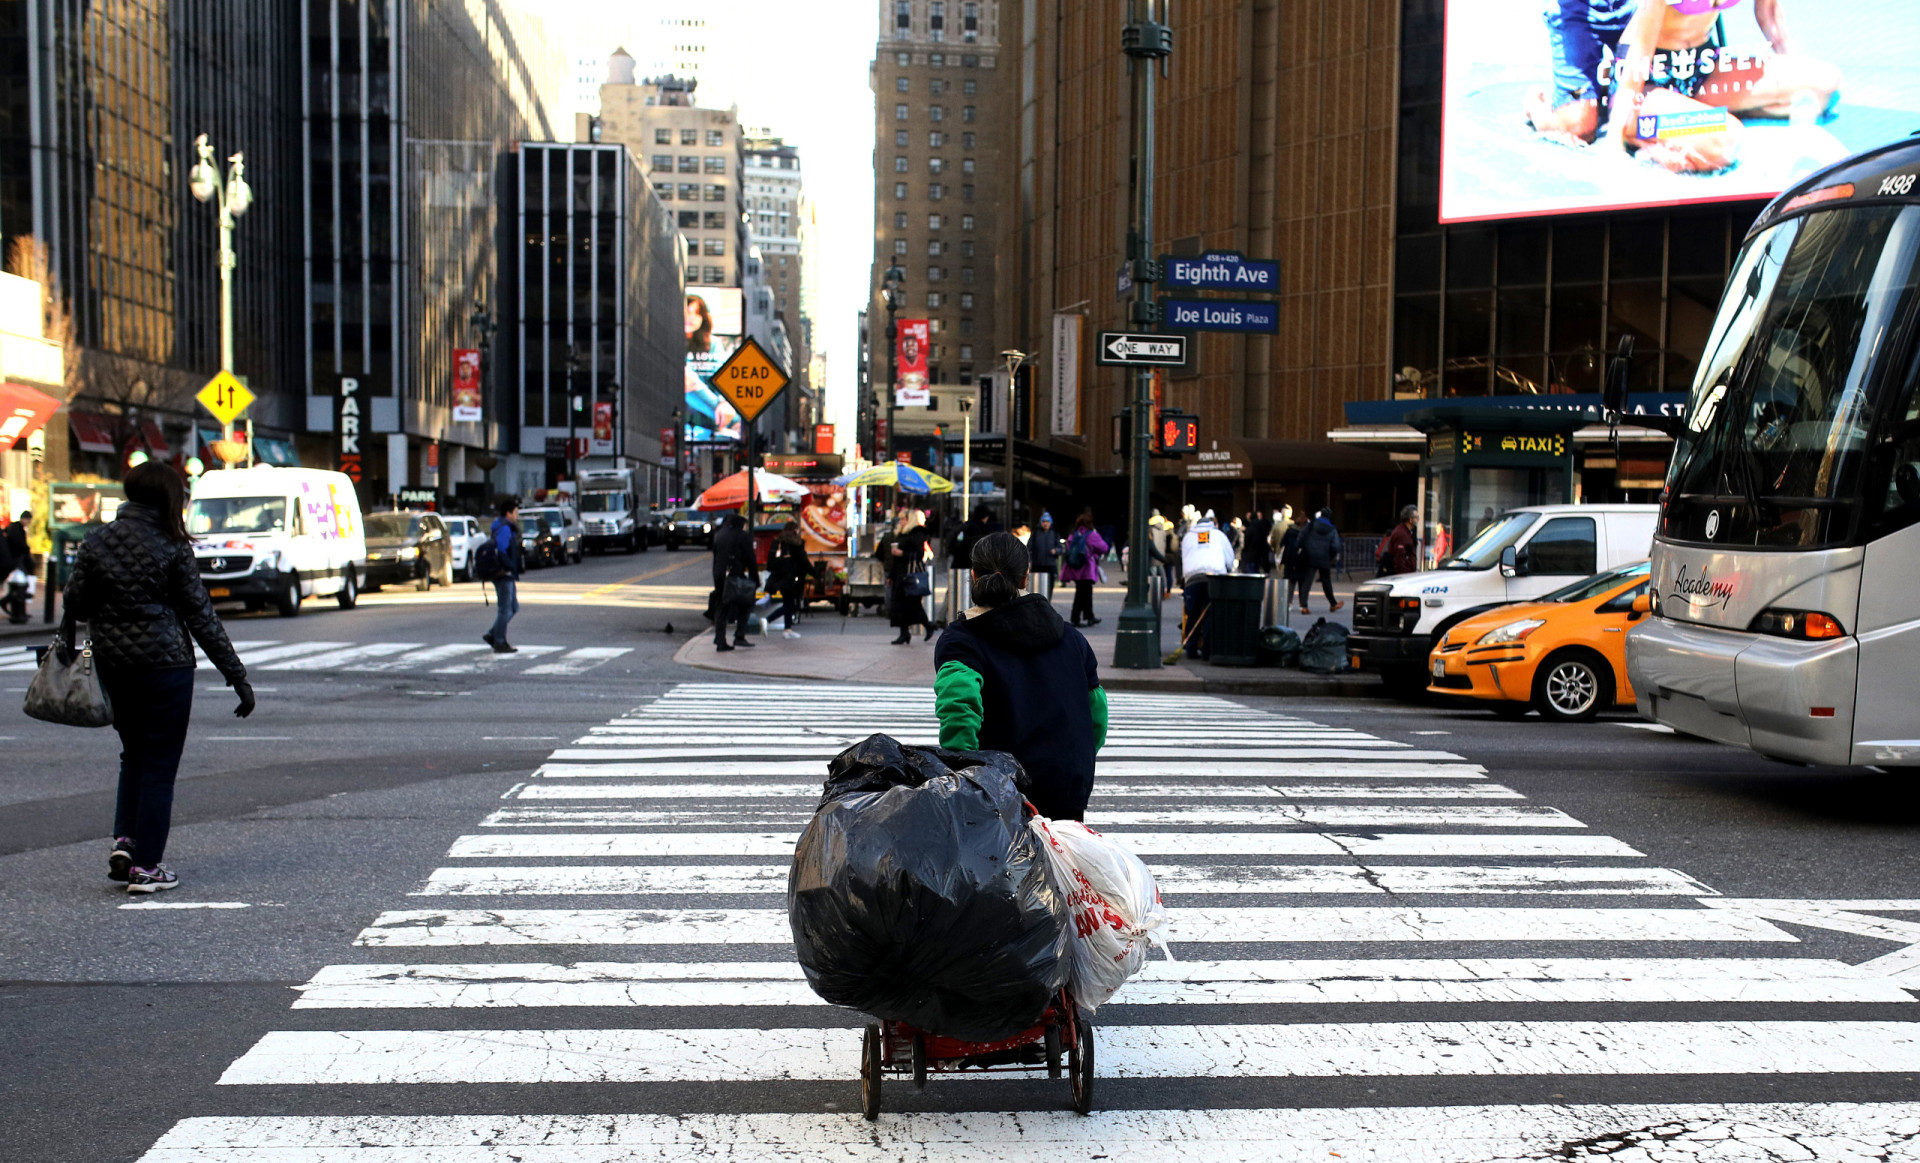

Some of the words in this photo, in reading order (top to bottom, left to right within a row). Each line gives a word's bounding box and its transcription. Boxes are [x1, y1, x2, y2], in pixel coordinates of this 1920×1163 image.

[1877, 174, 1917, 196] 1498
[1175, 263, 1230, 285] Eighth
[1235, 266, 1269, 283] Ave
[1174, 306, 1199, 323] Joe
[1204, 307, 1242, 325] Louis
[1246, 314, 1269, 324] Plaza
[1116, 342, 1138, 353] ONE
[1148, 344, 1173, 354] WAY
[731, 366, 769, 379] DEAD
[736, 385, 764, 398] END
[341, 377, 360, 454] PARK
[1187, 423, 1197, 447] 8
[1518, 436, 1552, 451] TAXI
[402, 490, 436, 502] PARK
[1422, 586, 1449, 594] 204
[1674, 564, 1733, 611] Academy
